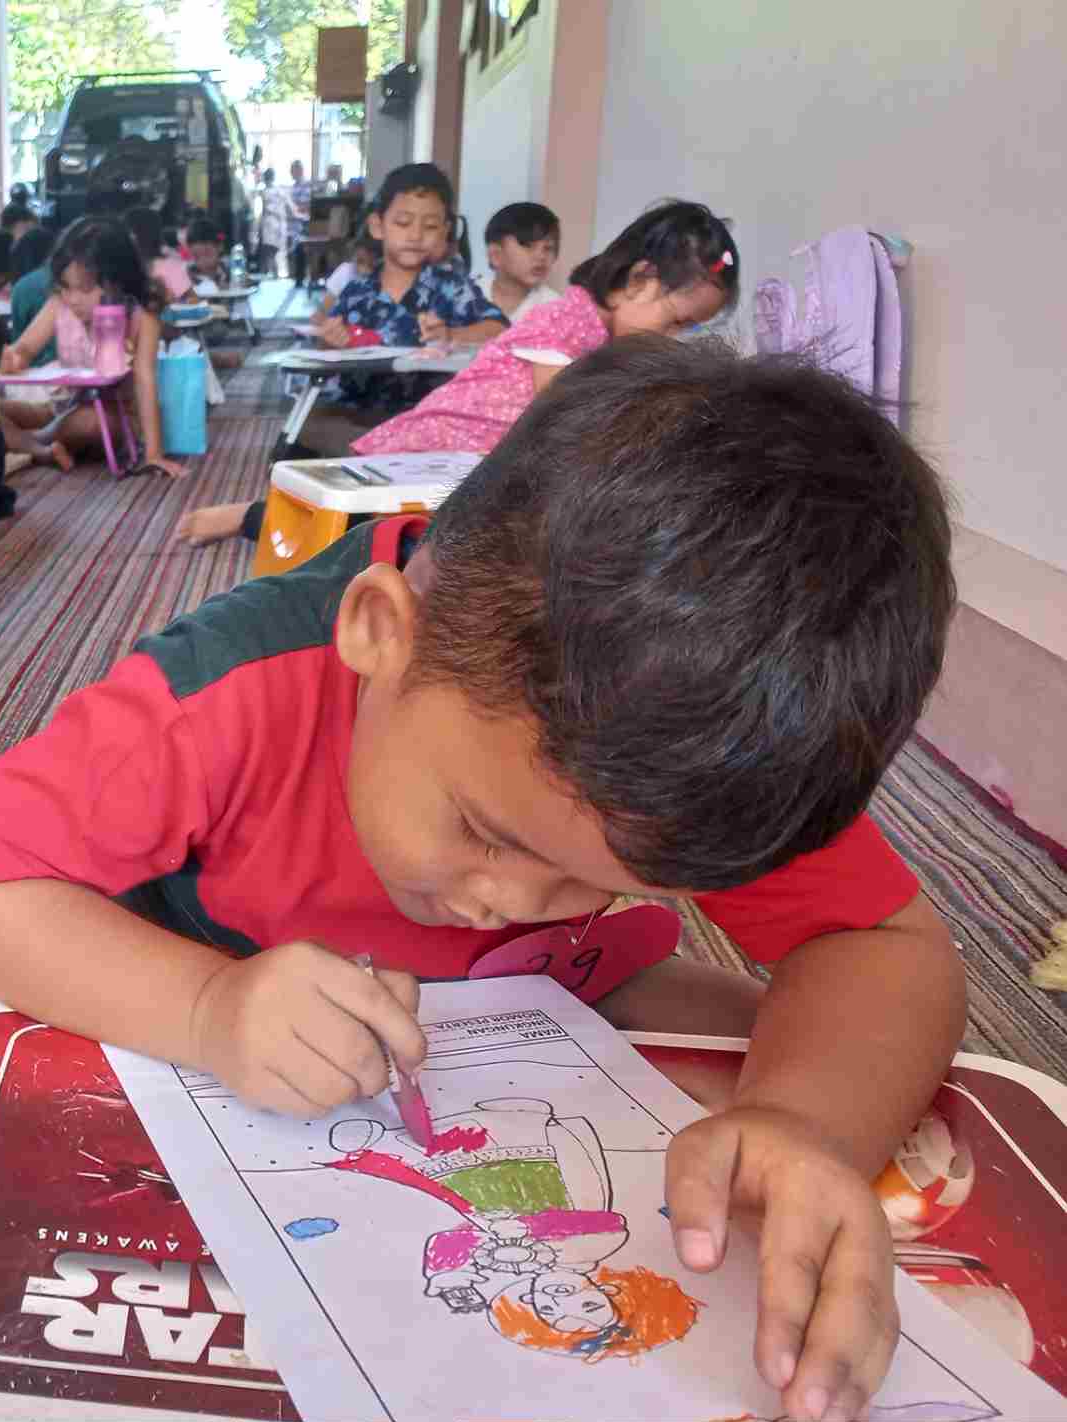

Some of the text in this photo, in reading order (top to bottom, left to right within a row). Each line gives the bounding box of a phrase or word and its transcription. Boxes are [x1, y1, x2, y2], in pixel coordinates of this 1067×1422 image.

[493, 1010, 543, 1022] NOMOR
[466, 1019, 552, 1035] LINGKUNGAN
[518, 1027, 563, 1039] NAMA
[37, 1227, 181, 1253] AWAKENS
